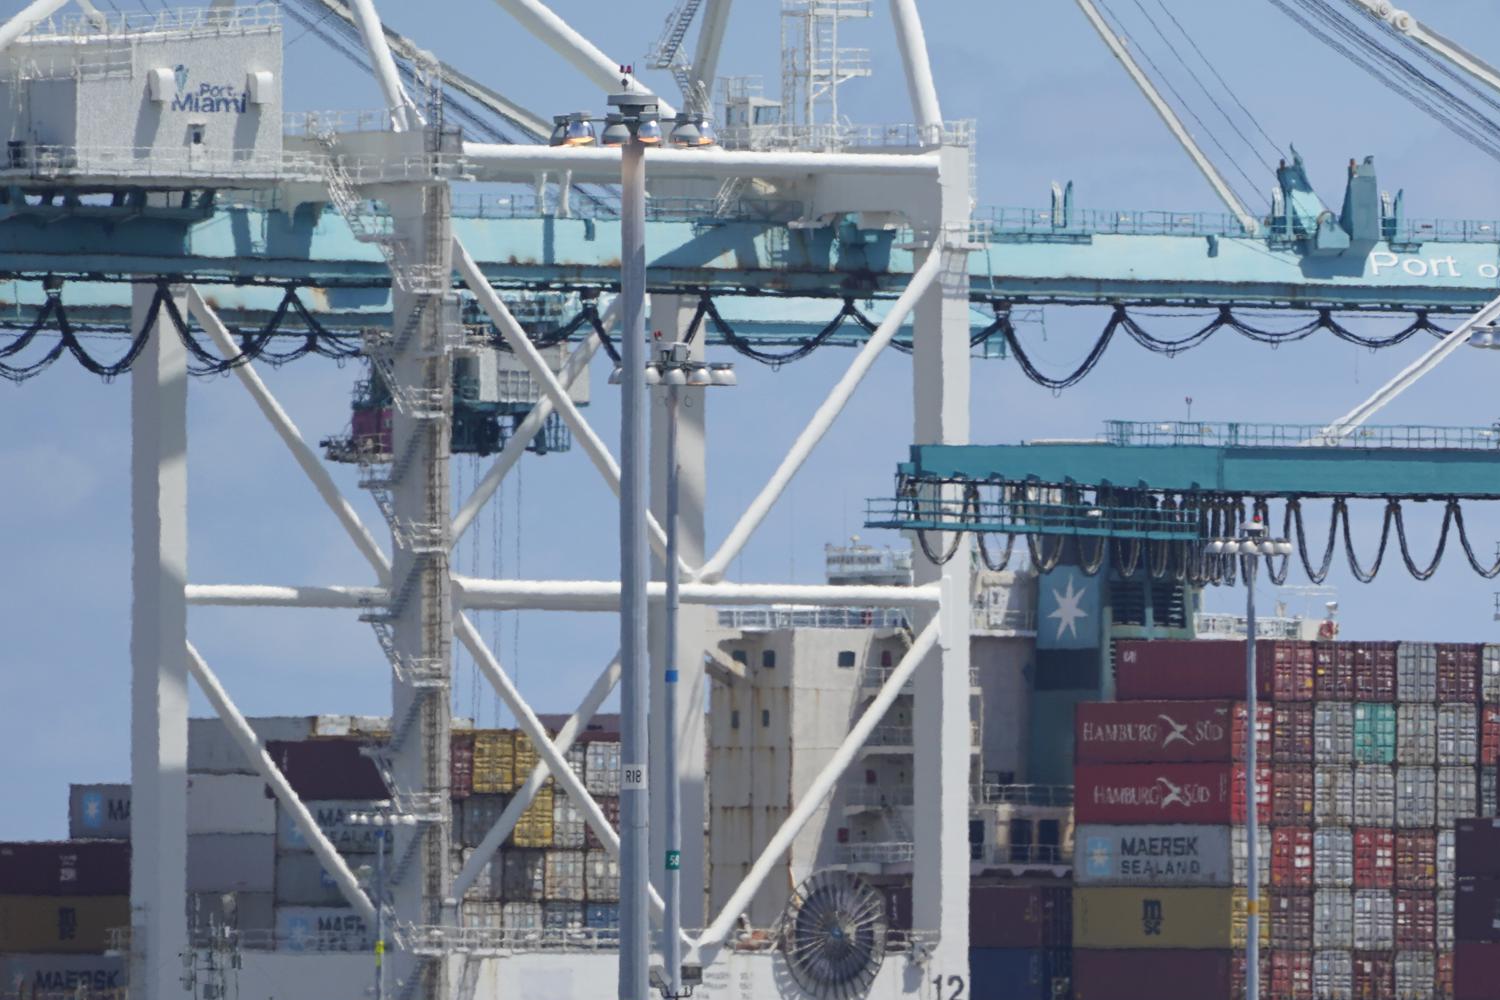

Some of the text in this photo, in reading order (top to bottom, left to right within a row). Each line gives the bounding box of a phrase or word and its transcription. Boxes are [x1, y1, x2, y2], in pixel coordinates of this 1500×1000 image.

[199, 82, 238, 97] Port
[171, 92, 247, 113] Miami
[1370, 252, 1460, 276] Port
[1083, 720, 1224, 742] HAMBURG SÜD
[624, 769, 642, 783] R18
[1093, 784, 1161, 804] HAMBURG
[1181, 783, 1210, 803] SÜD
[1120, 837, 1198, 857] MAERSK
[1120, 860, 1200, 874] SEALAND
